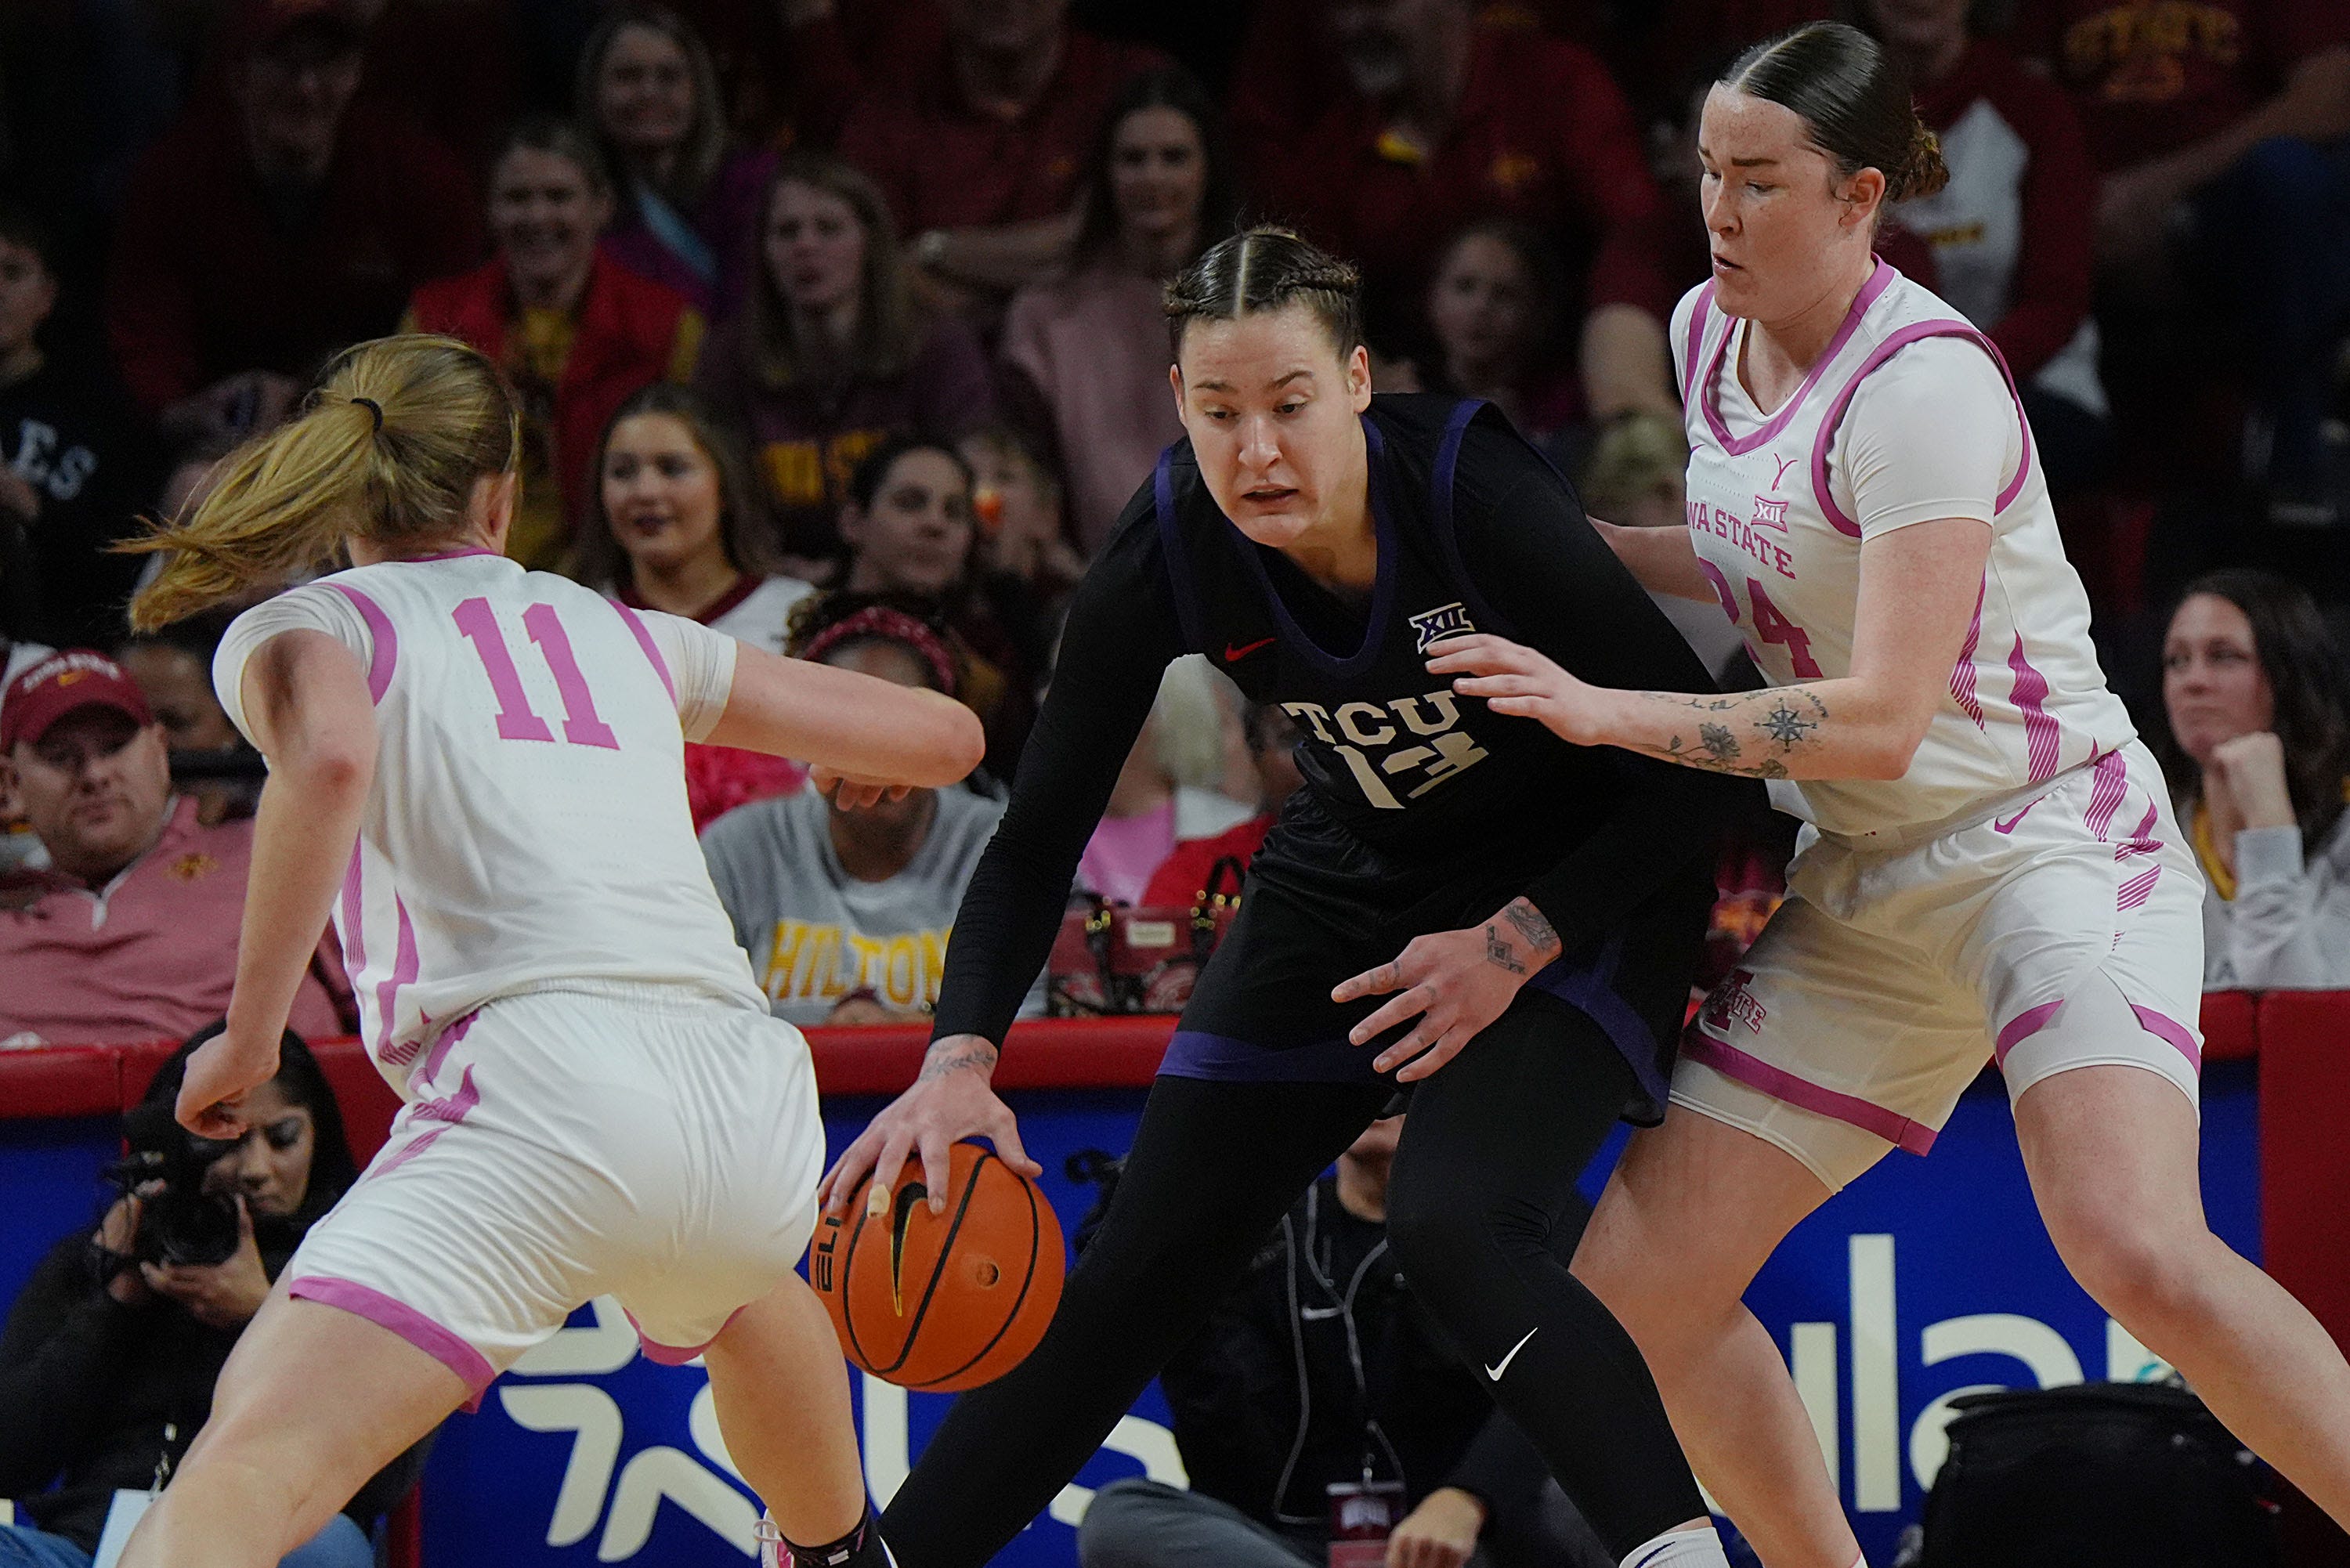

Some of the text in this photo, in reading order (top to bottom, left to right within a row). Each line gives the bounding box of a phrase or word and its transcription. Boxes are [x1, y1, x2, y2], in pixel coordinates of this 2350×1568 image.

[1685, 500, 1796, 580] WA STATE
[450, 596, 621, 751] 11
[1279, 689, 1461, 746] TCU
[761, 919, 955, 1005] HILTON
[816, 1216, 842, 1292] ELI
